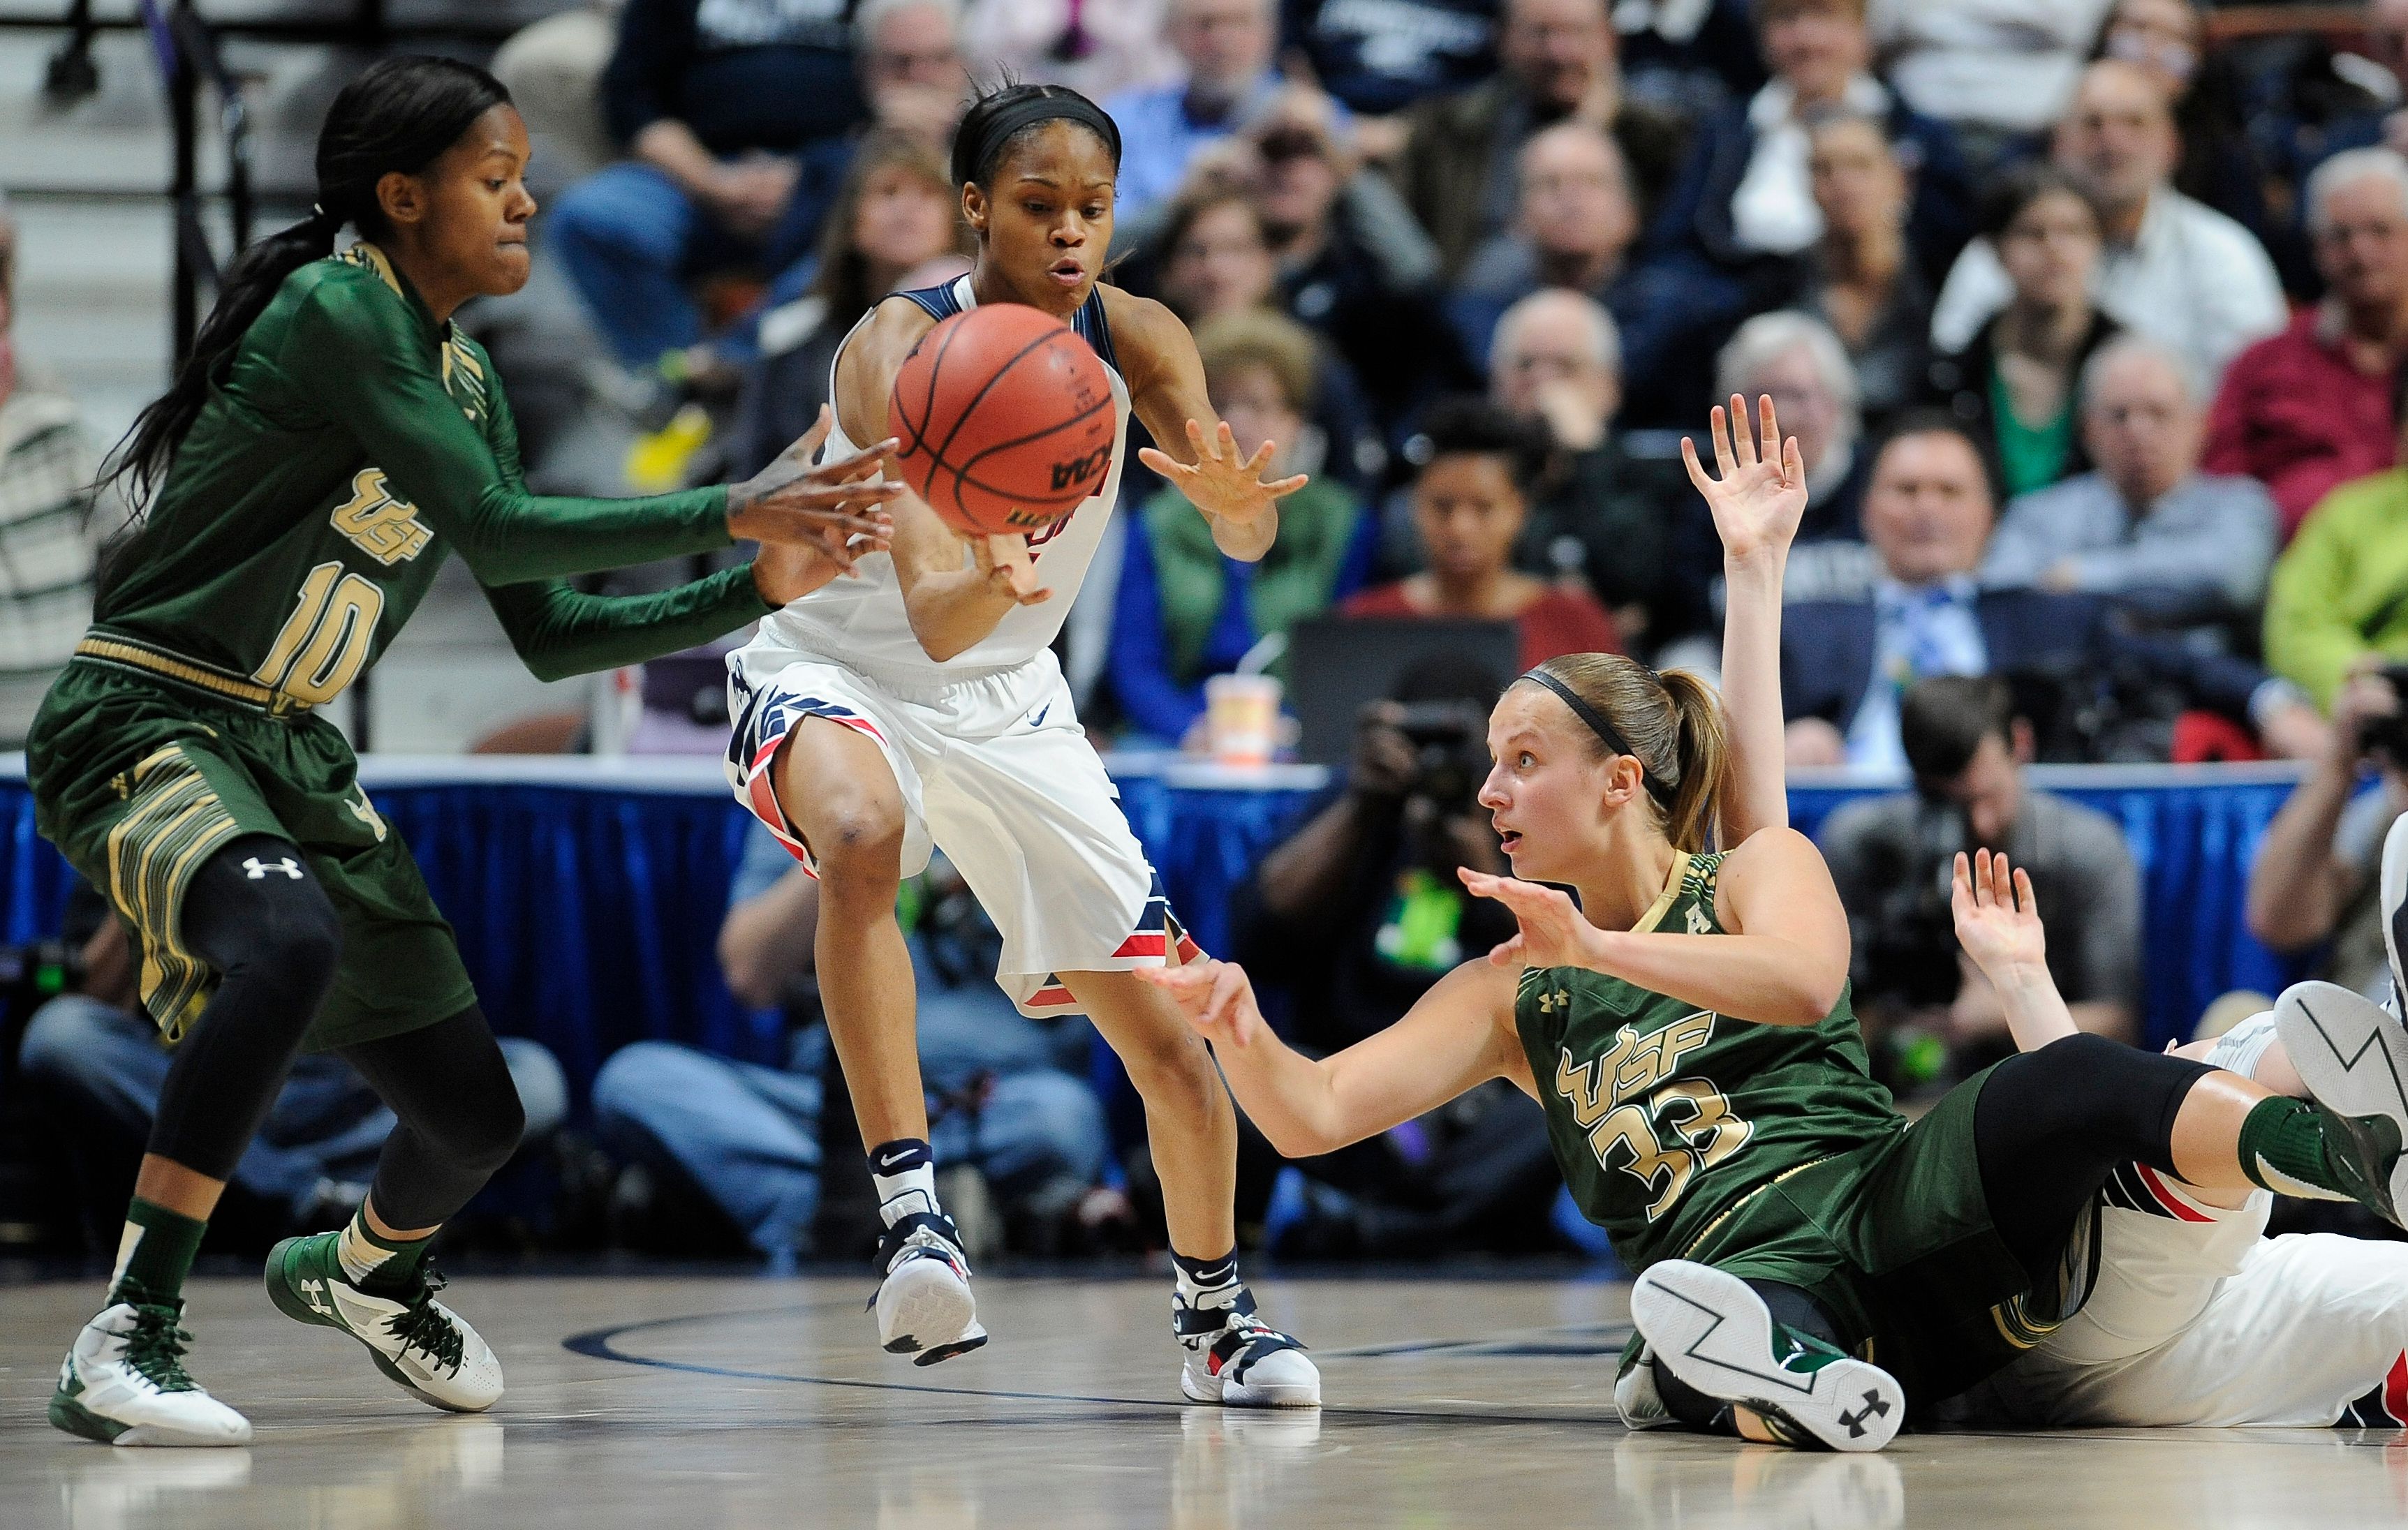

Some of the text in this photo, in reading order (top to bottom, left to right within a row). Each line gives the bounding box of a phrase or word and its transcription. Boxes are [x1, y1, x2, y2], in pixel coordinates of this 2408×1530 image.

[330, 468, 434, 566] USF
[1051, 437, 1114, 491] CAA
[249, 560, 385, 704] 10
[1556, 1010, 1717, 1129] USF
[1588, 1077, 1755, 1224] 33
